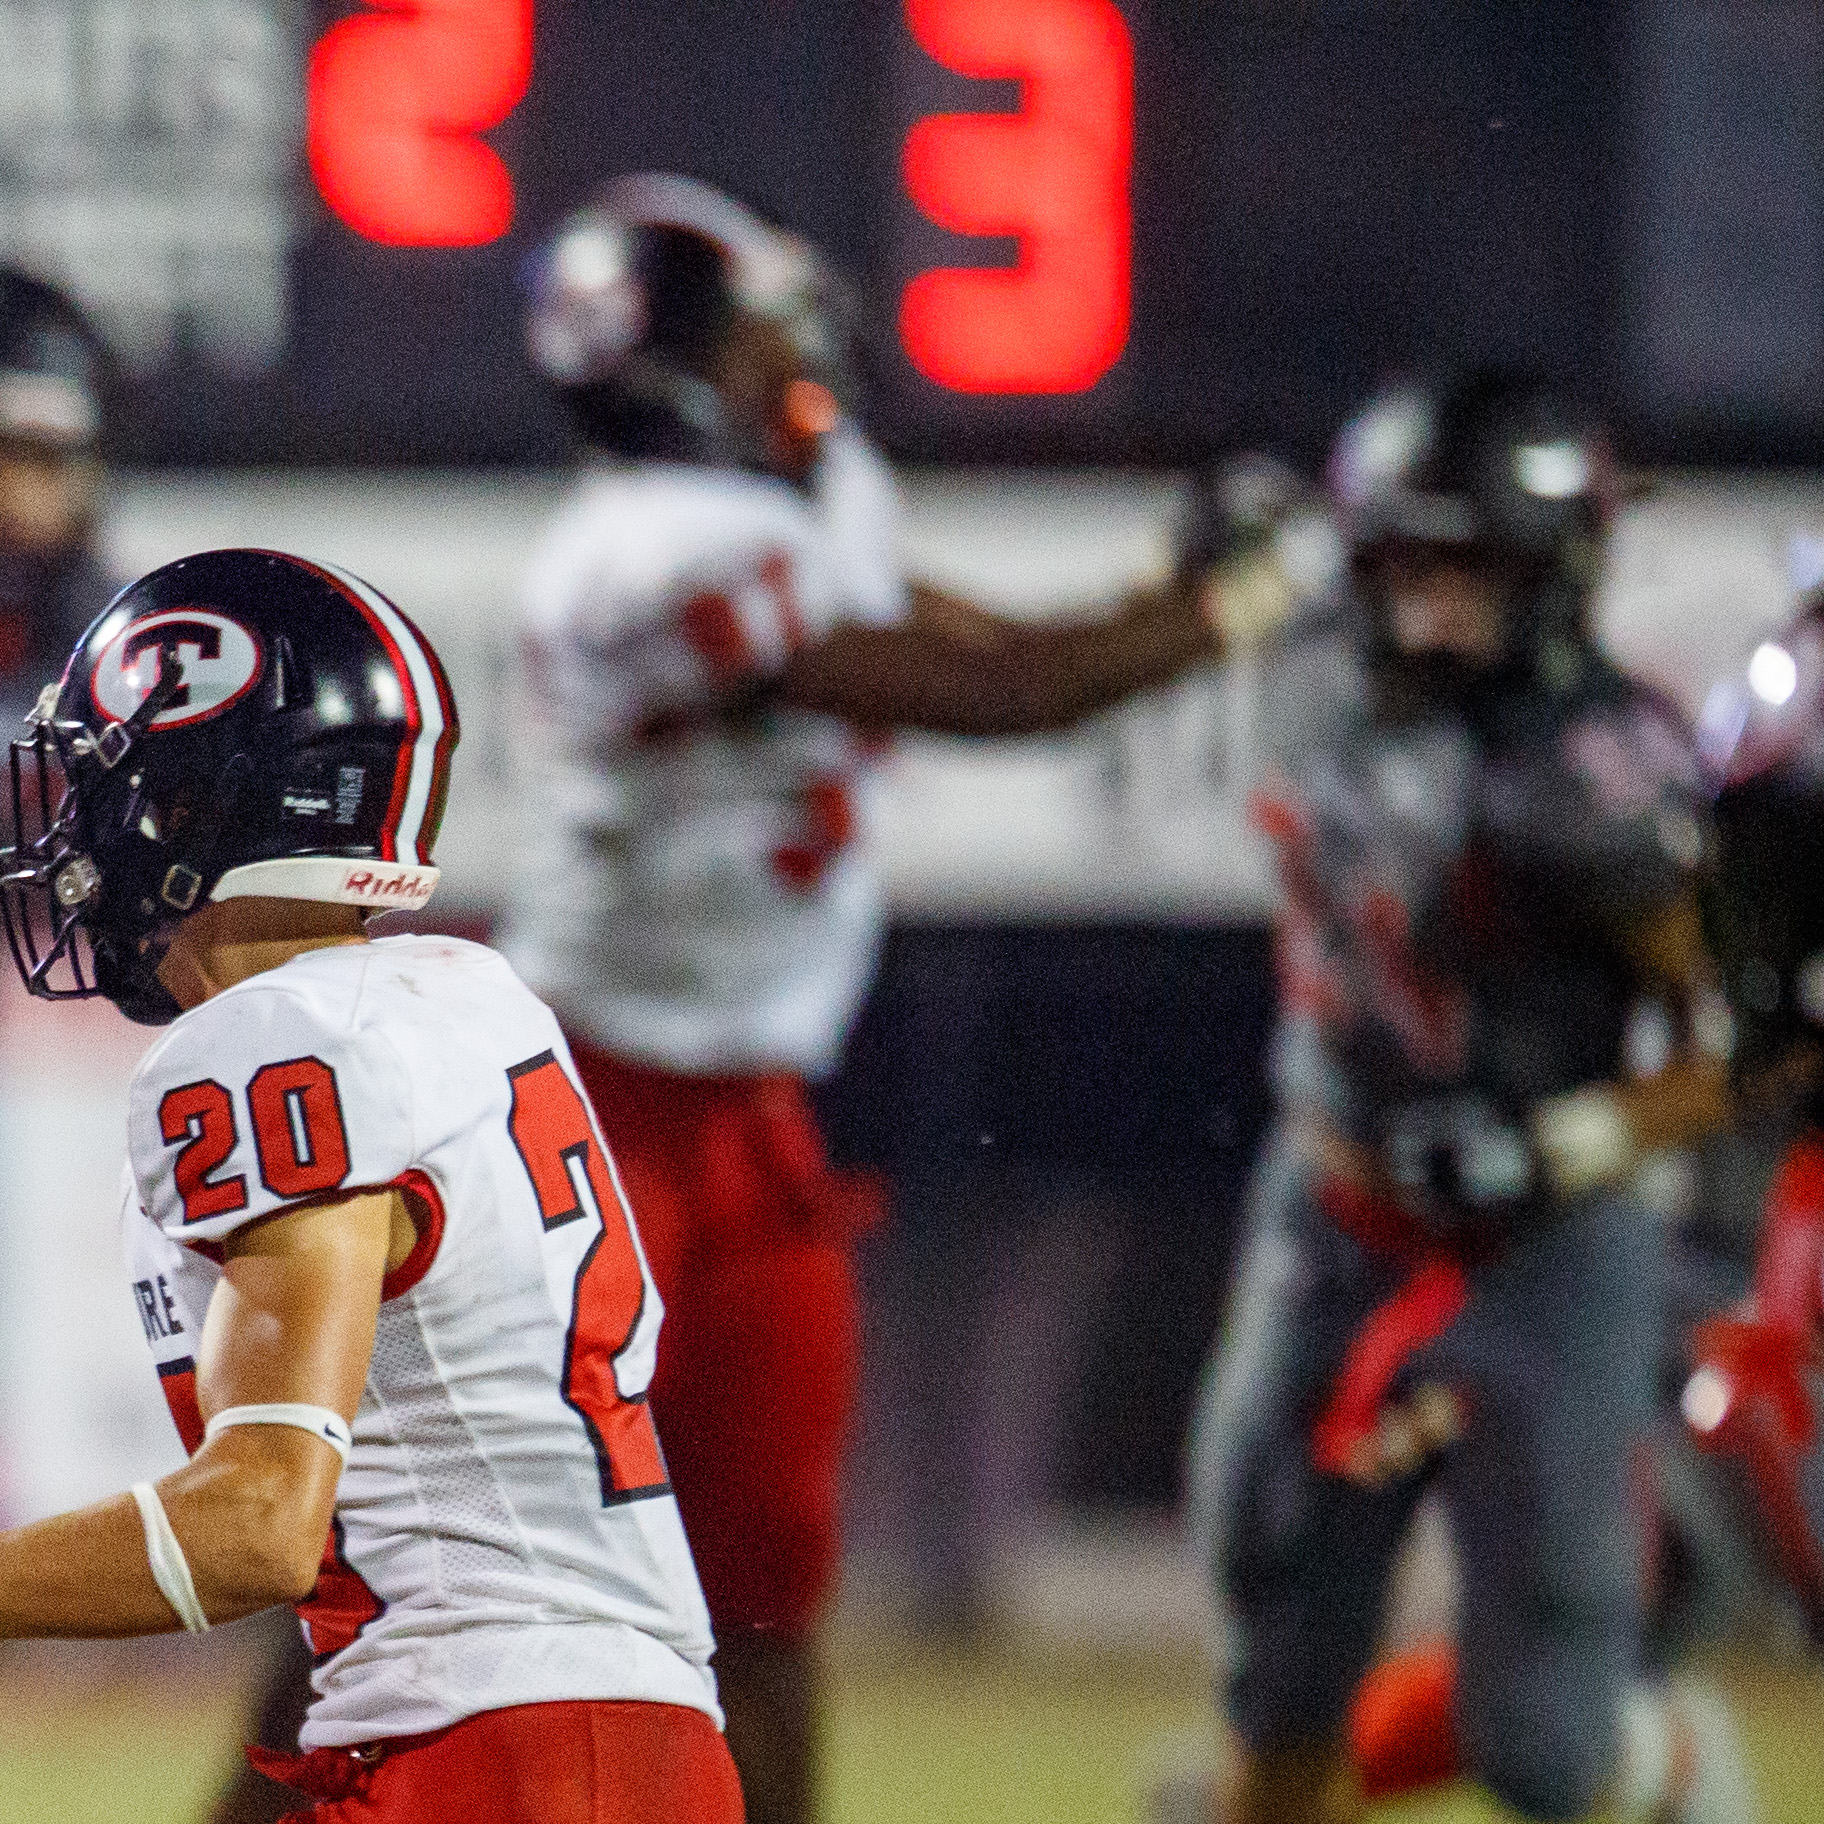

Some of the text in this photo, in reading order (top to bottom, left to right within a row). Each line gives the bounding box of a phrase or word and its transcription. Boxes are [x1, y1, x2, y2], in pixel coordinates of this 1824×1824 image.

[899, 0, 1134, 395] 3
[120, 619, 221, 709] T
[157, 1054, 352, 1223] 20
[132, 1273, 185, 1346] RE
[504, 1046, 672, 1508] 2
